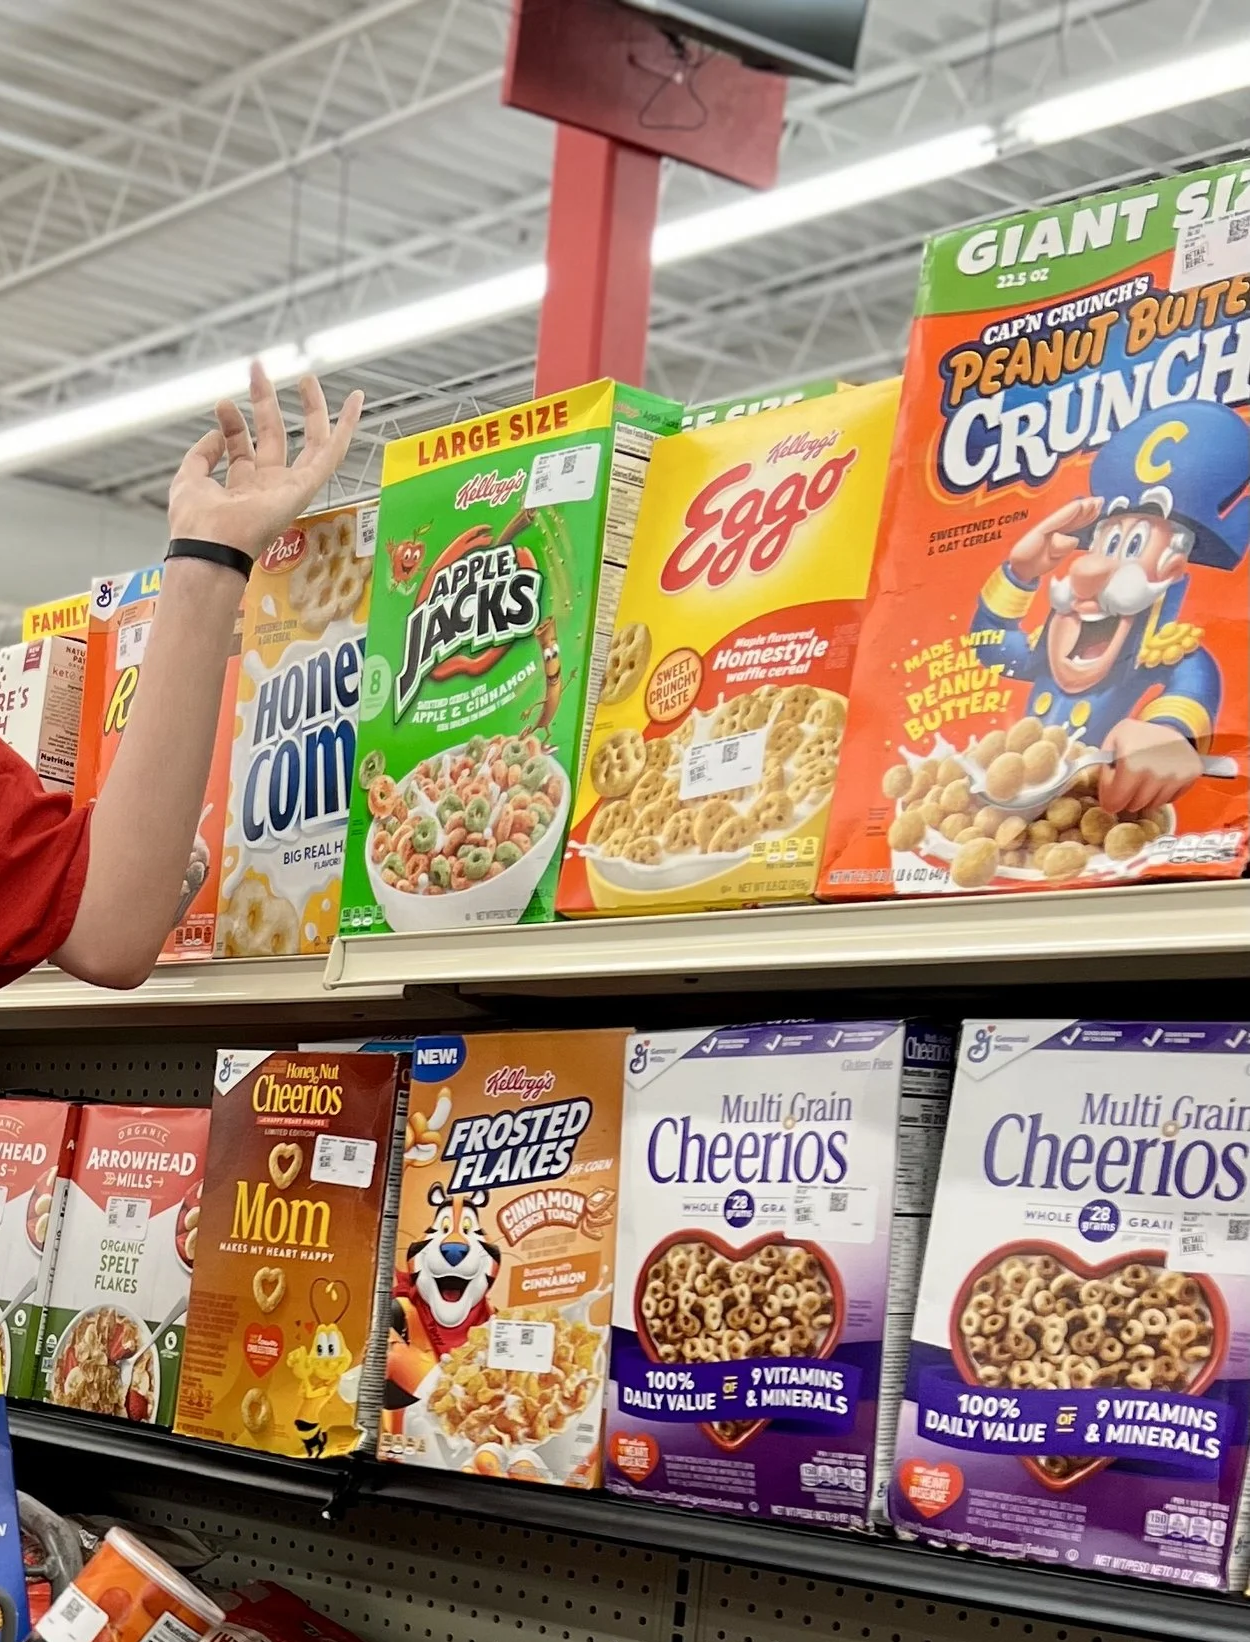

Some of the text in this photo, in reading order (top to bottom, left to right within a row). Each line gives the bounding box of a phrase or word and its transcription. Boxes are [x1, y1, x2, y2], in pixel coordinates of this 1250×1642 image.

[956, 193, 1158, 275] GIANT
[996, 268, 1048, 289] 22.5 OZ
[983, 275, 1150, 345] CAP'N CRUNCH'S
[949, 311, 1118, 405] PEANUT
[942, 318, 1250, 488] CRUNCH
[417, 400, 569, 467] LARGE SIZE
[1135, 421, 1189, 484] C
[660, 447, 857, 594] Eggo
[930, 510, 1029, 544] SWEETENED CORN
[266, 536, 302, 565] Post
[938, 530, 1003, 554] OAT CEREAL
[429, 543, 517, 605] APPLE
[32, 605, 90, 634] FAMILY
[395, 567, 545, 725] JACKS
[961, 629, 1005, 648] WITH
[712, 637, 829, 672] Homestyle
[928, 649, 981, 680] REAL
[412, 710, 446, 723] APPLE
[451, 706, 461, 718] &
[466, 661, 536, 713] CINNAMON
[650, 667, 699, 705] CRUNCHY
[906, 664, 1005, 714] PEANUT
[657, 689, 691, 715] TASTE
[904, 691, 1011, 741] BUTTER!
[283, 844, 330, 865] BIG REAL
[318, 1062, 340, 1080] Nut
[417, 1048, 458, 1066] NEW!
[253, 1074, 344, 1116] Cheerios
[720, 1094, 784, 1125] Multi
[1080, 1093, 1164, 1129] Multi
[445, 1100, 590, 1159] FROSTED
[86, 1146, 197, 1176] ARROWHEAD
[450, 1137, 578, 1191] FLAKES
[648, 1116, 849, 1186] Cheerios
[983, 1113, 1249, 1202] Cheerios
[117, 1172, 154, 1189] MILLS
[231, 1179, 331, 1249] Mom
[502, 1190, 585, 1231] CINNAMON
[682, 1203, 719, 1214] WHOLE
[1024, 1209, 1072, 1223] WHOLE
[100, 1238, 145, 1255] ORGANIC
[218, 1241, 335, 1264] MAKES HEART HAPPY
[99, 1254, 139, 1276] SPELT
[94, 1274, 138, 1294] FLAKES
[521, 1270, 586, 1293] CINNAMON
[645, 1370, 695, 1391] 100%
[723, 1380, 739, 1395] OF
[765, 1366, 845, 1391] VITAMINS
[623, 1387, 717, 1412] DAILY VALUE
[759, 1389, 849, 1415] MINERALS
[957, 1393, 1021, 1419] 100%
[924, 1411, 1048, 1444] DAILY VALUE
[1057, 1412, 1077, 1426] OF
[1112, 1400, 1219, 1432] VITAMINS
[1105, 1426, 1222, 1459] MINERALS
